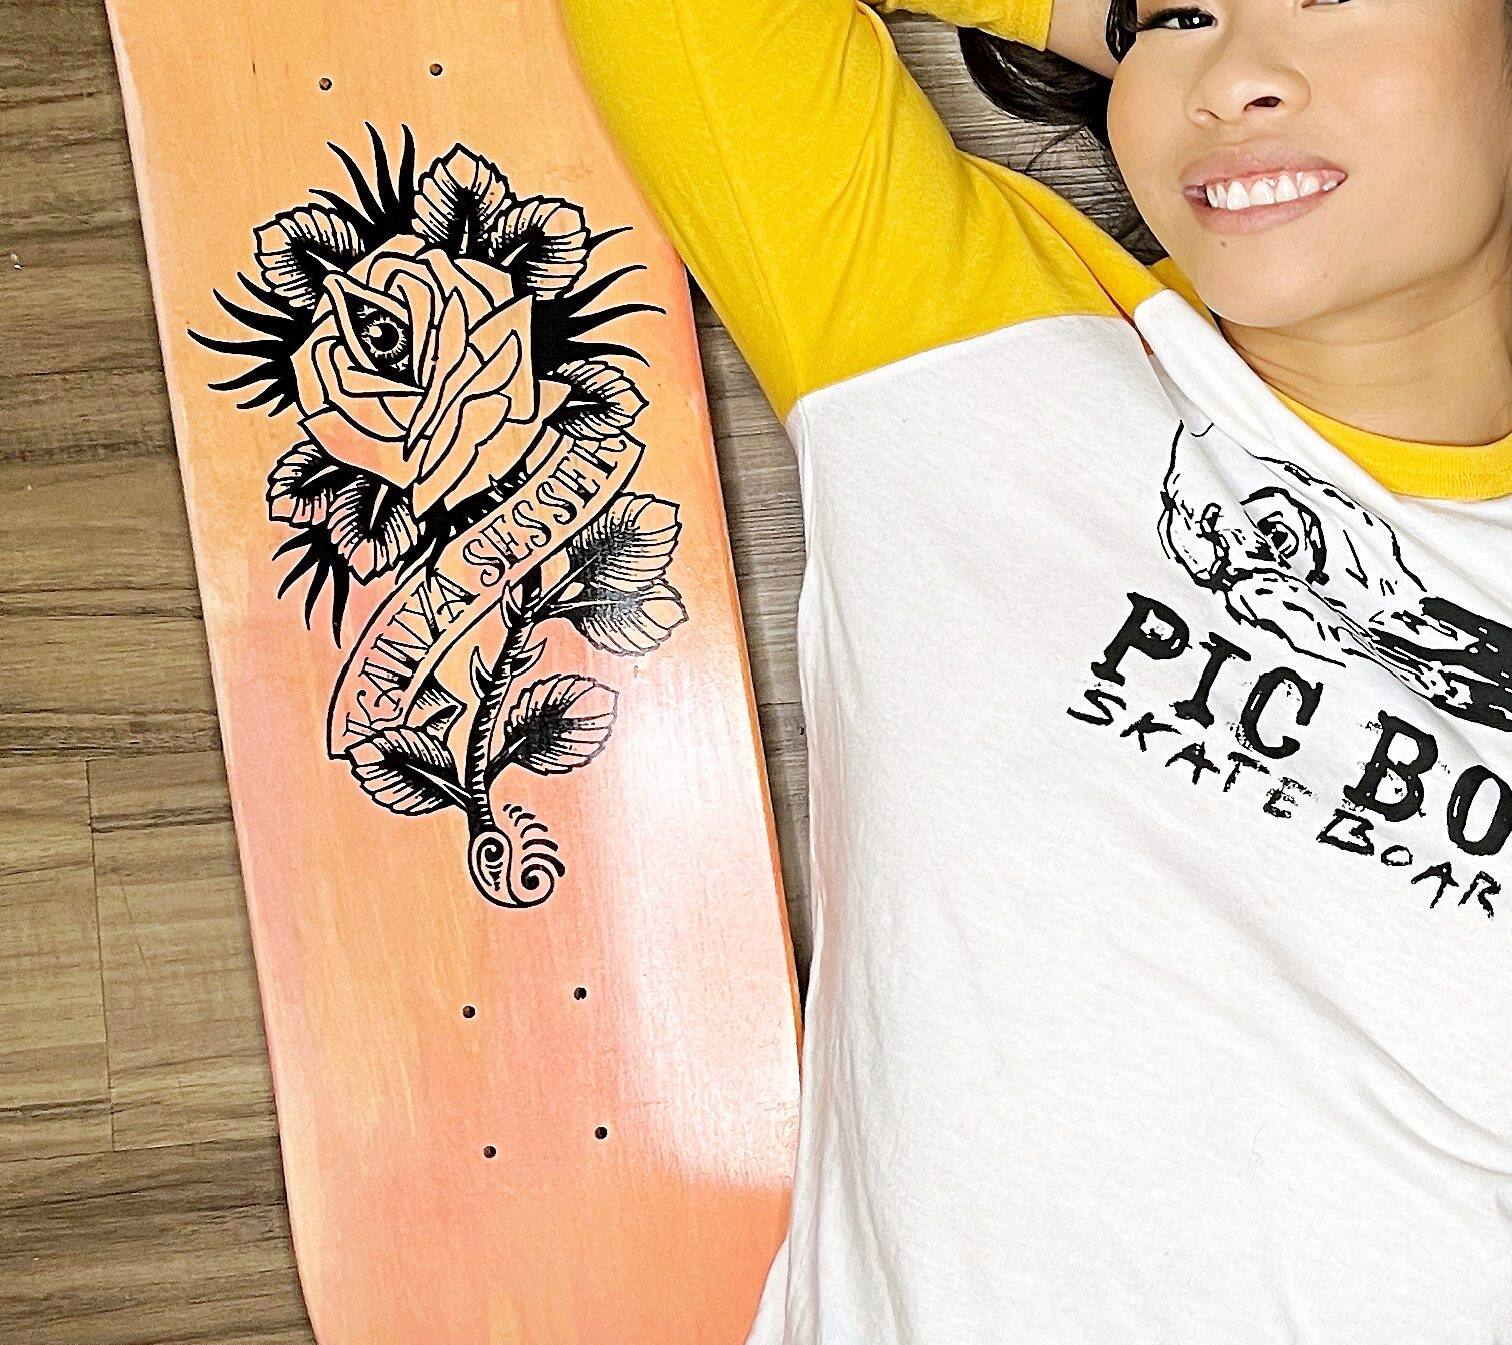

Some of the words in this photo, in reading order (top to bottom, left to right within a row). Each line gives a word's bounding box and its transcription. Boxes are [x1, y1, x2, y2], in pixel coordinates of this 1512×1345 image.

[343, 568, 480, 737] KANYA
[462, 436, 628, 587] SESSER
[1091, 592, 1323, 760] PIC
